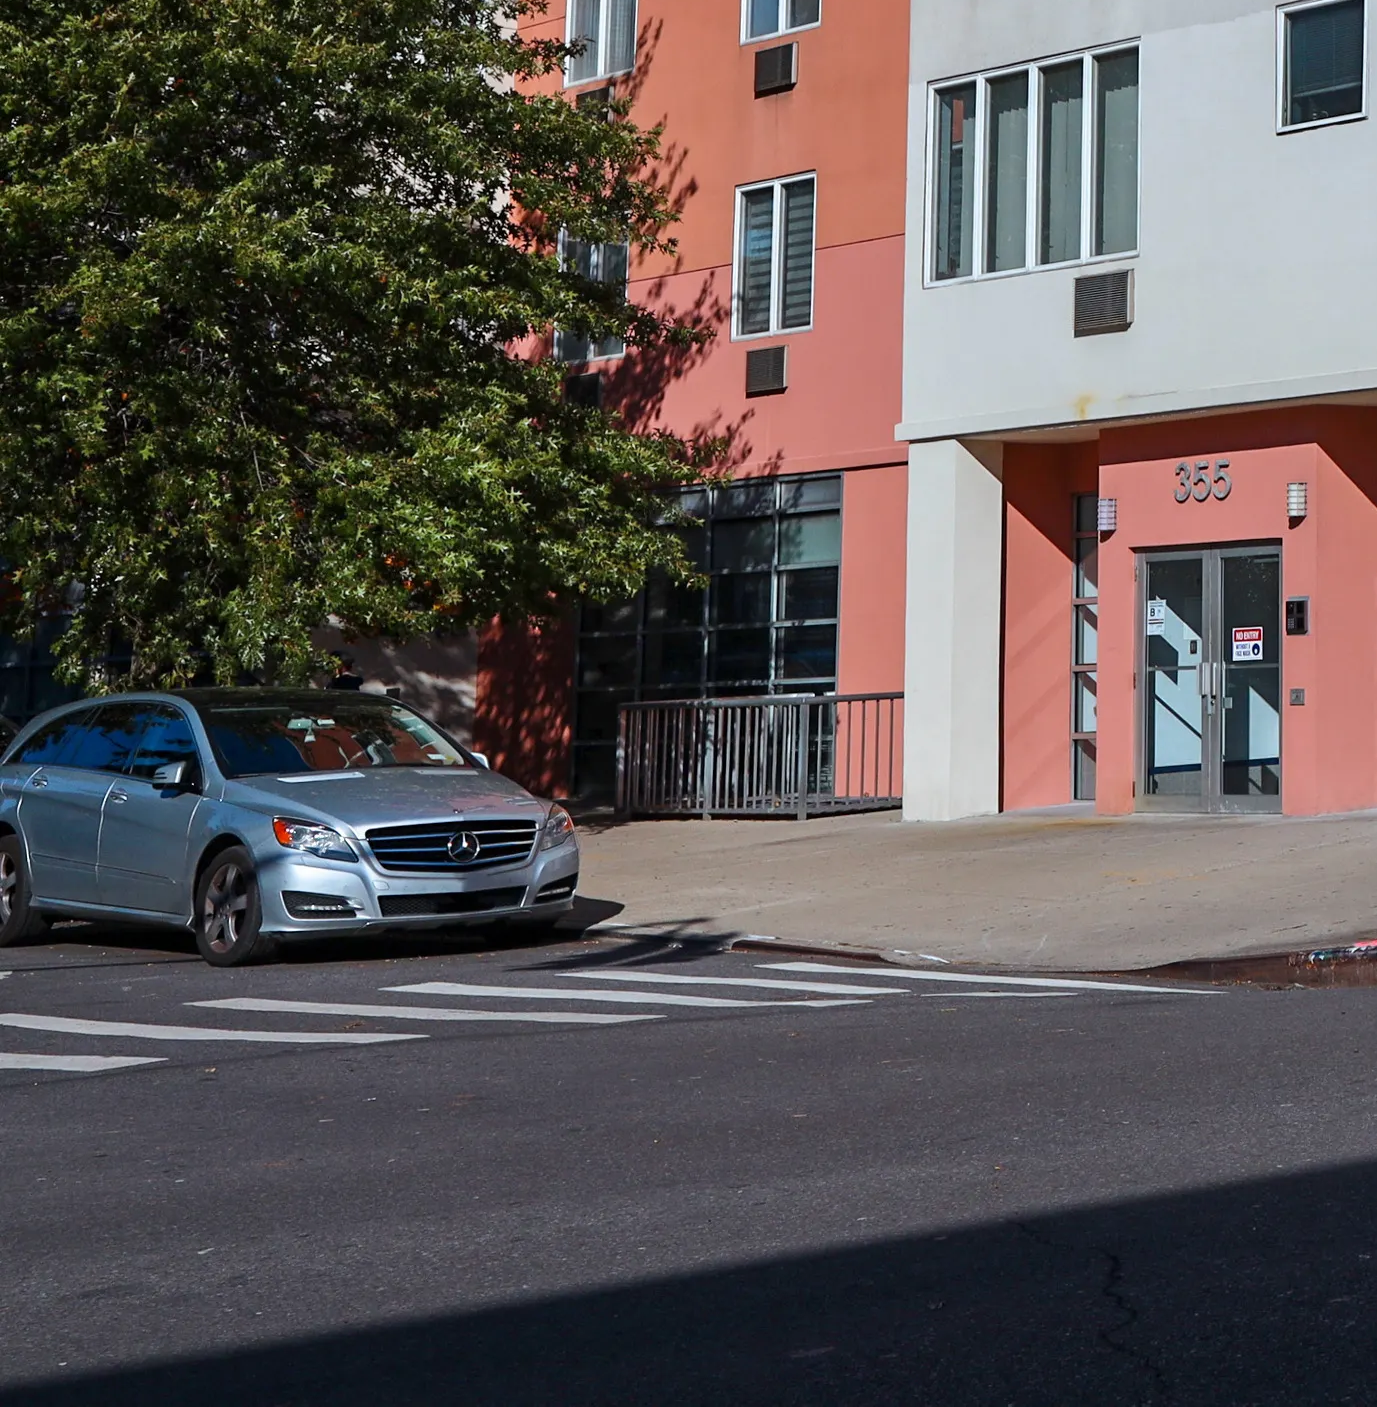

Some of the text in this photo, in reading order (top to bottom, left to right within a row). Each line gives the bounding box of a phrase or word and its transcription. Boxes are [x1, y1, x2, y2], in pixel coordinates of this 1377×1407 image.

[1174, 460, 1232, 504] 355
[1235, 630, 1259, 640] NO ENTRY
